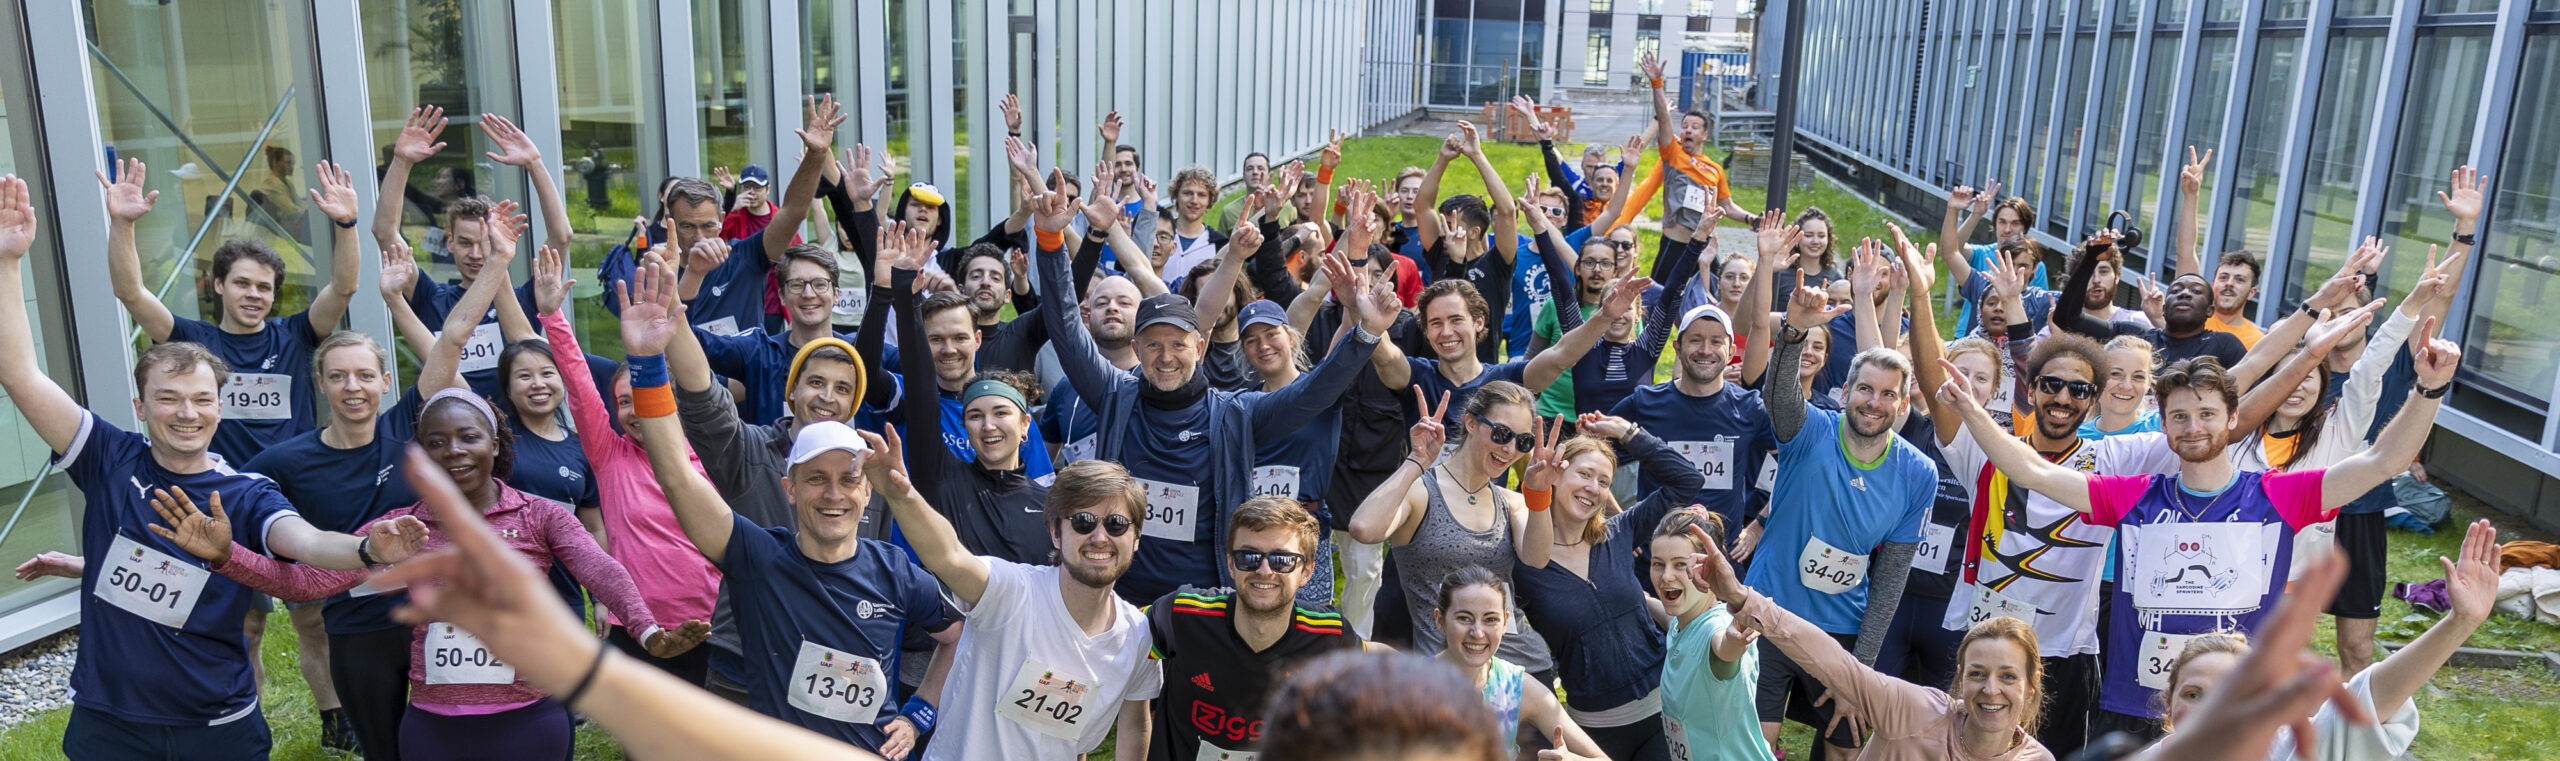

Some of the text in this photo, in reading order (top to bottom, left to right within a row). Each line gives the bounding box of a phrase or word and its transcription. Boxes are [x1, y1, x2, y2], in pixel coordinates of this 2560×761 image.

[460, 342, 496, 361] 9-01
[227, 391, 282, 407] 19-03
[1992, 390, 2007, 402] 04
[1256, 482, 1292, 497] 4-04
[1146, 503, 1185, 526] 3-01
[1917, 542, 1939, 560] 01
[1804, 559, 1856, 586] 34-02
[109, 565, 183, 610] 50-01
[2149, 656, 2175, 675] 34
[806, 673, 875, 708] 13-03
[1014, 689, 1083, 725] 21-02
[1192, 700, 1268, 741] Zigg
